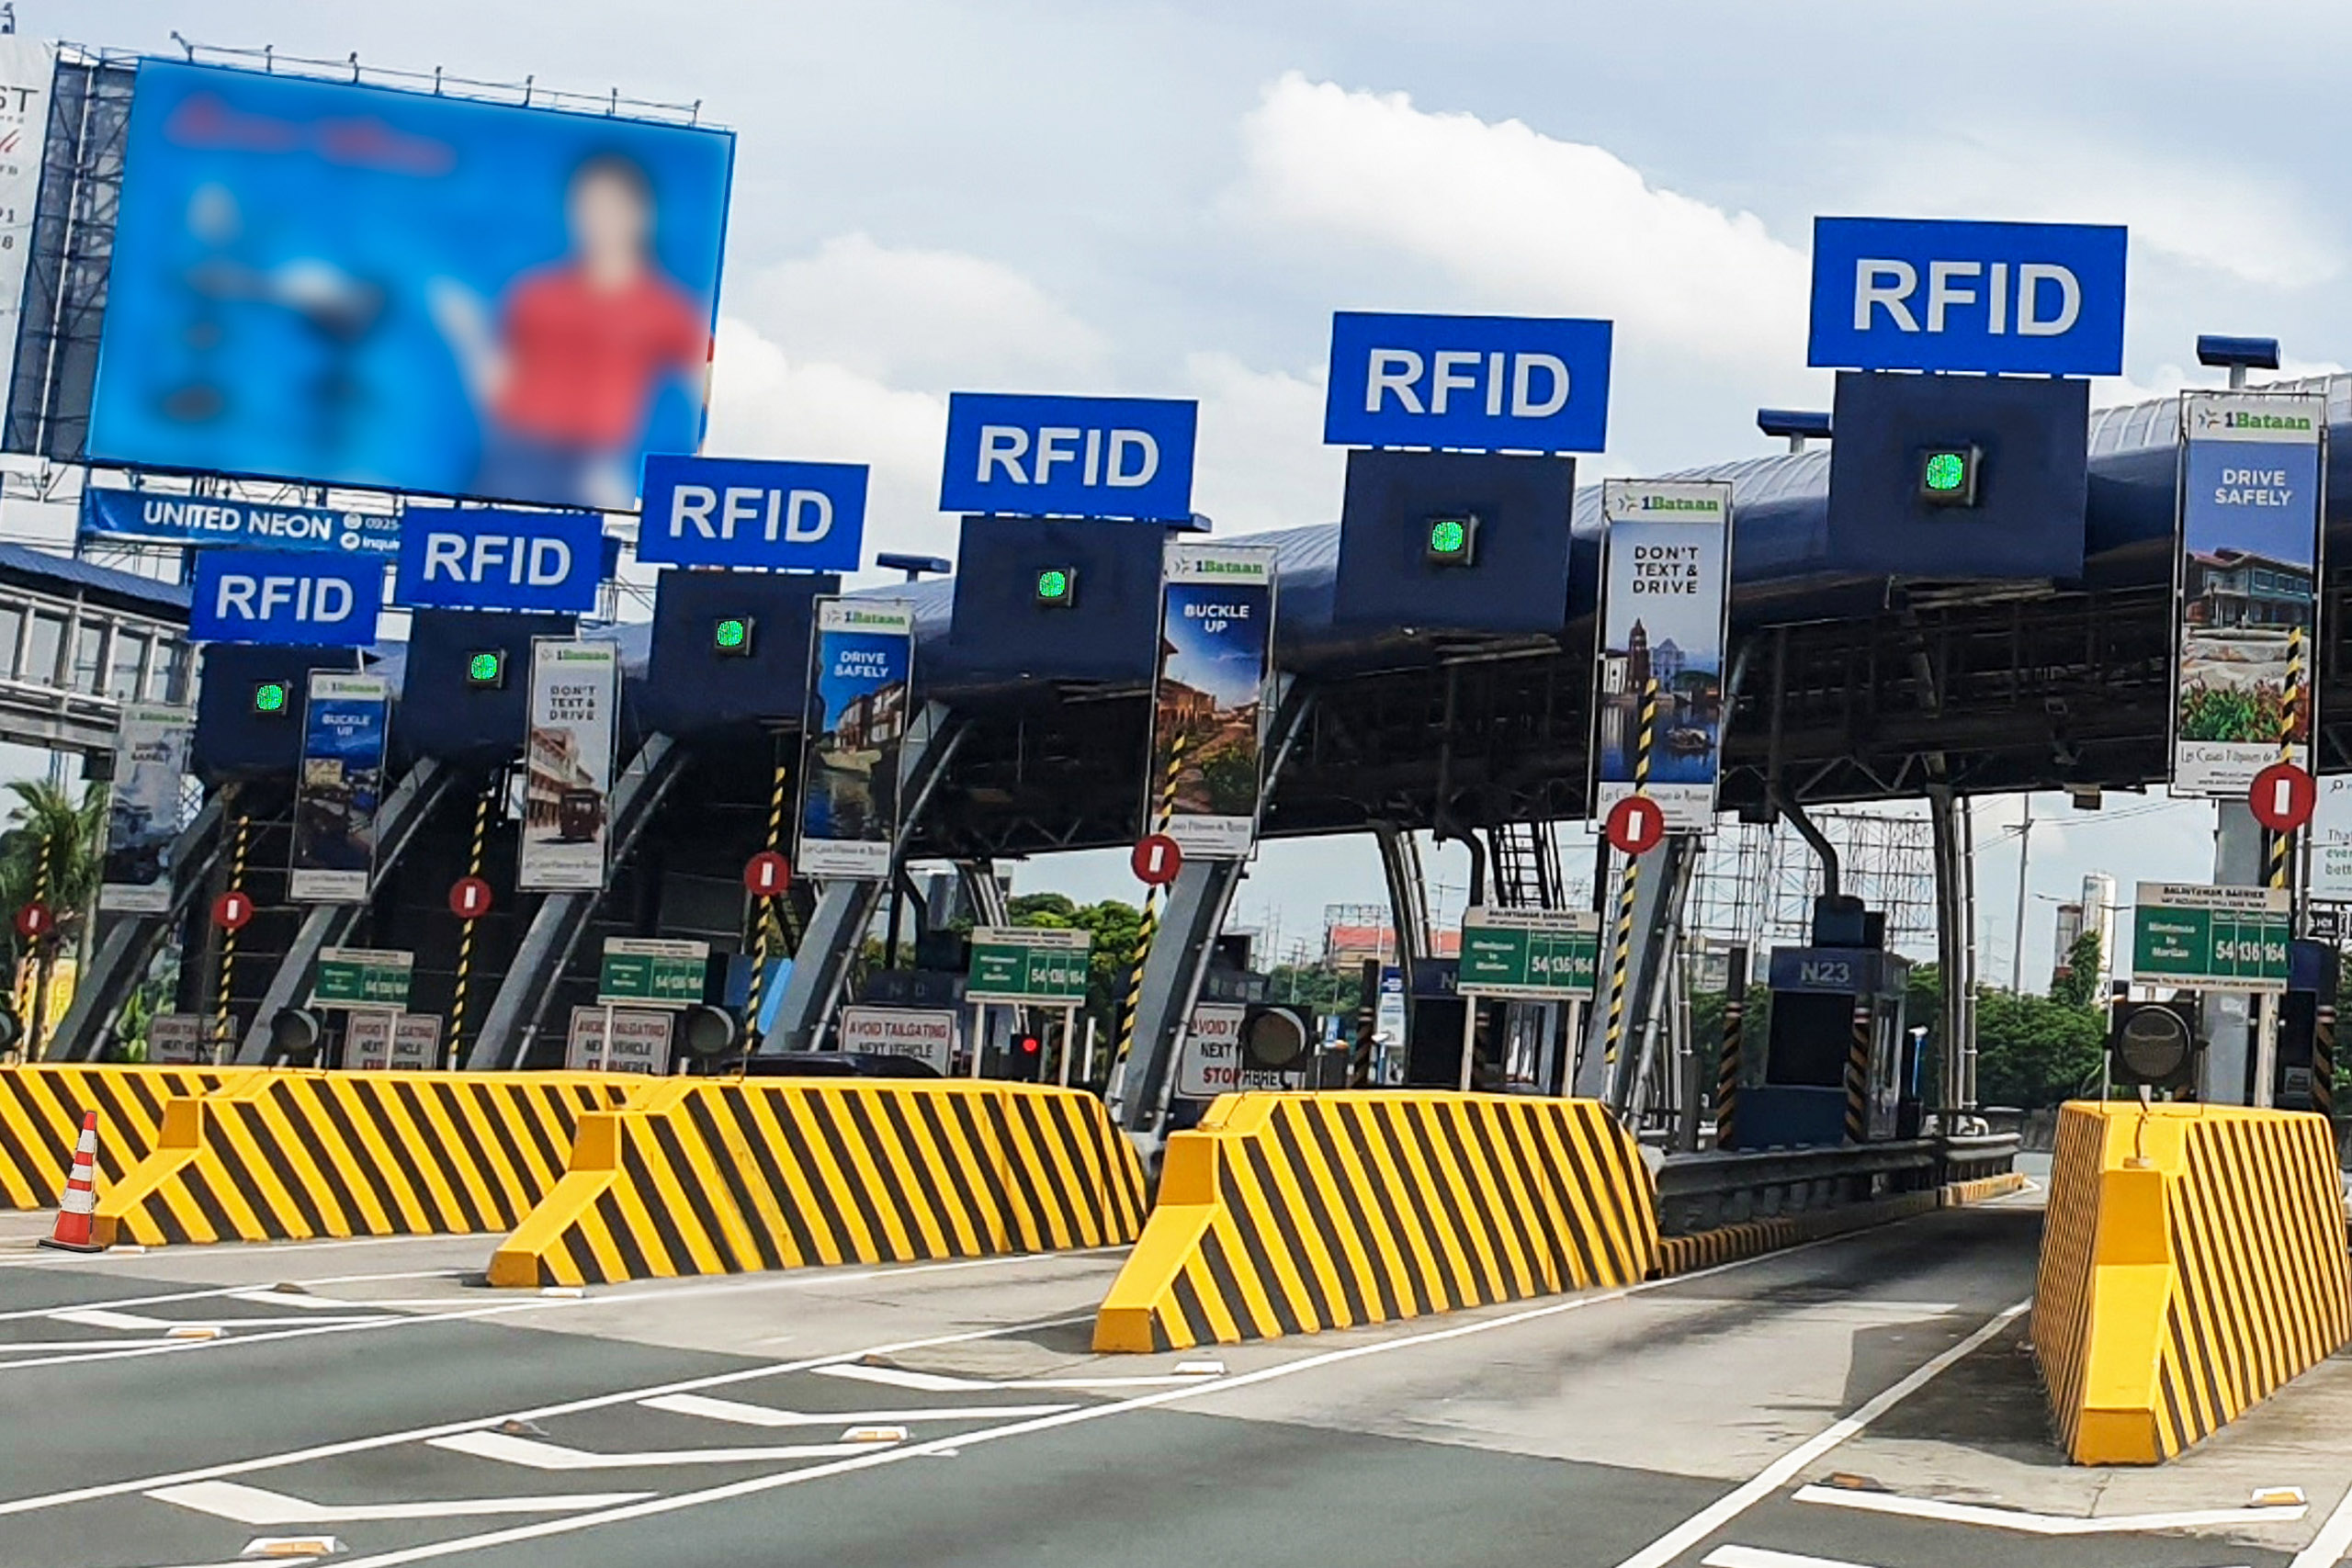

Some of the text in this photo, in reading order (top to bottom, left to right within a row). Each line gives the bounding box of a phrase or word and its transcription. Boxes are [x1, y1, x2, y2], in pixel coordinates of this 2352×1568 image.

[1854, 260, 2079, 335] RFID
[1366, 349, 1569, 416] RFID
[2224, 412, 2311, 430] 1Bataan
[978, 426, 1158, 486] RFID
[2222, 468, 2286, 487] DRIVE
[1641, 496, 1718, 512] 1Bataan
[2214, 487, 2292, 506] SAFELY
[143, 500, 333, 541] UNITED NEON
[671, 486, 832, 541] RFID
[424, 535, 571, 584] RFID
[1634, 545, 1699, 560] DON'T
[1195, 559, 1262, 574] 1Bataan
[1634, 561, 1698, 577] TEXT &
[1633, 580, 1698, 594] DRIVE
[217, 575, 353, 622] RFID
[1183, 604, 1250, 618] BUCKLE
[1204, 618, 1228, 633] UP
[840, 649, 887, 665] DRIVE
[833, 663, 889, 678] SAFELY
[550, 684, 596, 695] DON'T
[550, 697, 583, 708] TEXT
[548, 709, 595, 721] DRIVE
[2215, 940, 2234, 960] 54
[2264, 942, 2286, 962] 164
[1532, 955, 1549, 973] 54
[1801, 961, 1849, 984] N23
[848, 1021, 947, 1039] AVOID TAILGATING
[1201, 1042, 1233, 1058] NEXT
[1203, 1066, 1240, 1084] STOP
